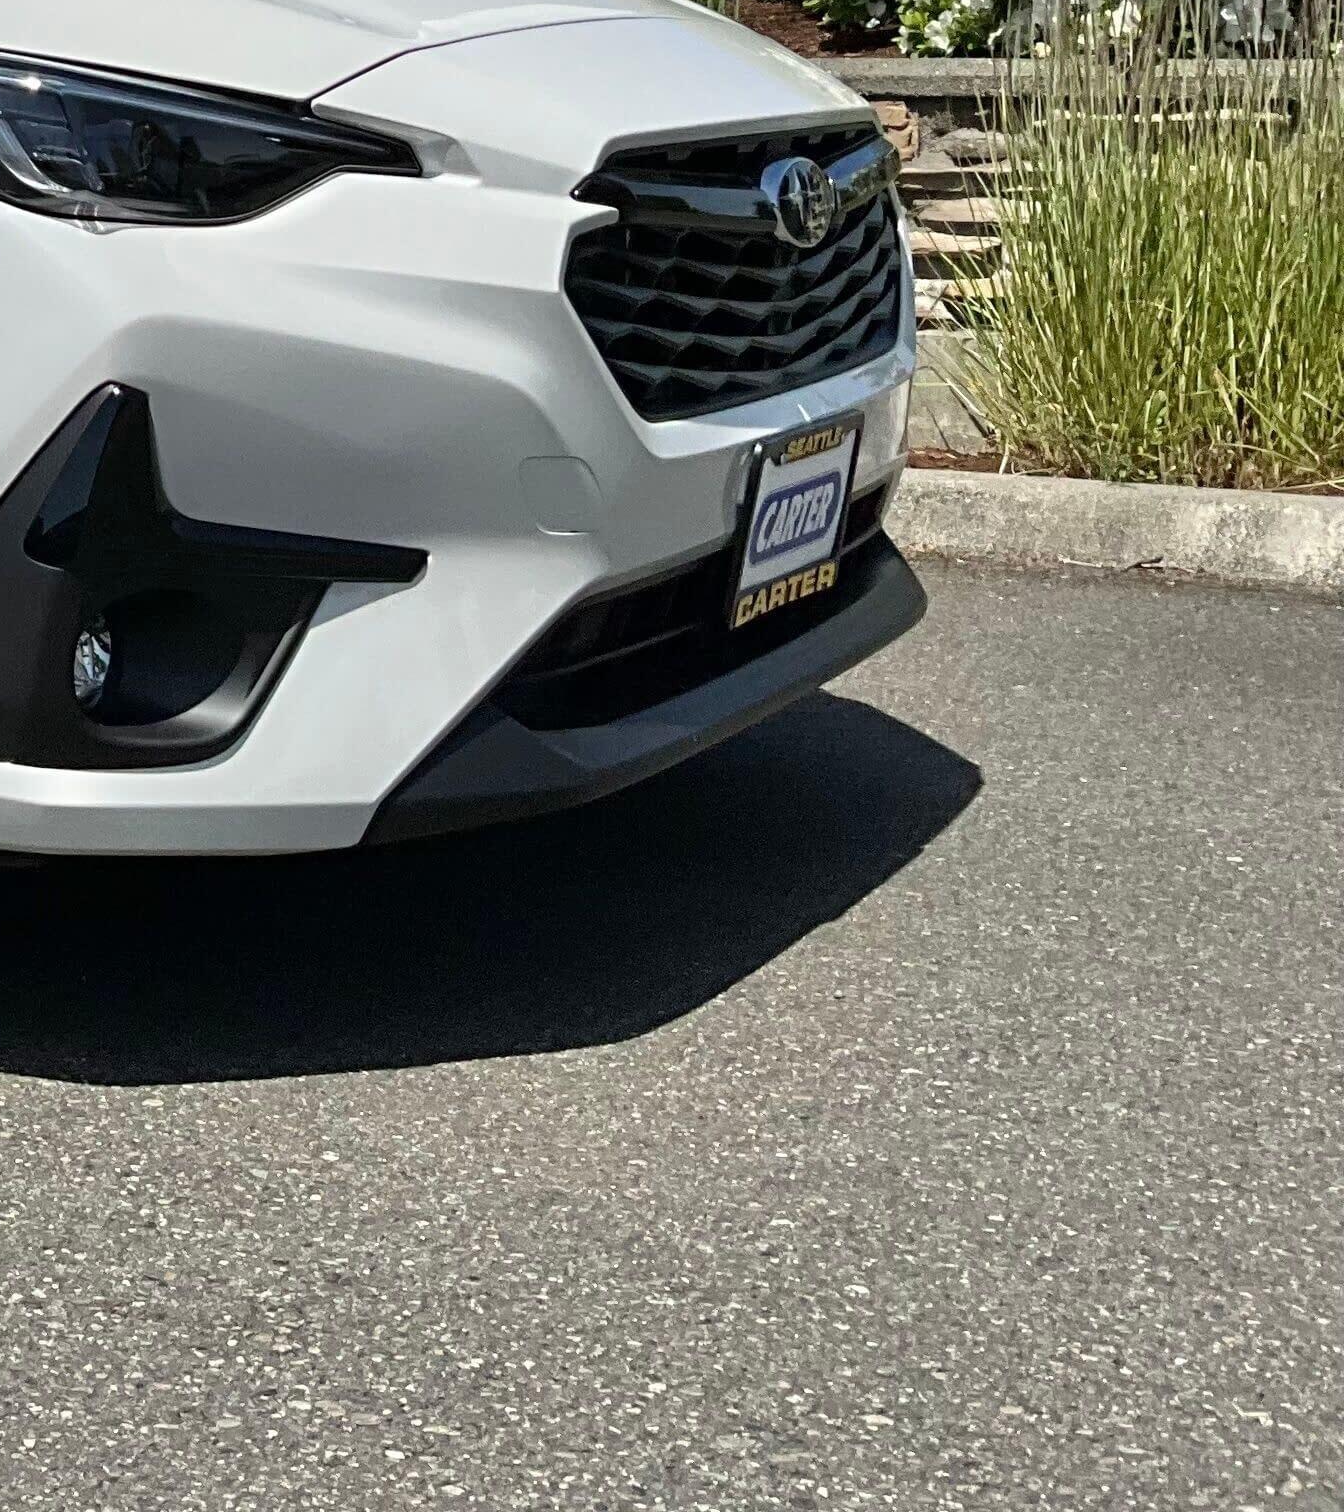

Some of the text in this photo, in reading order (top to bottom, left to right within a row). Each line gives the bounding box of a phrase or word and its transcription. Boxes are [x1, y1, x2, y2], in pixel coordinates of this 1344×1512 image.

[786, 428, 843, 461] SEATTLE
[756, 482, 835, 553] CARTER
[734, 562, 837, 627] CARTER
